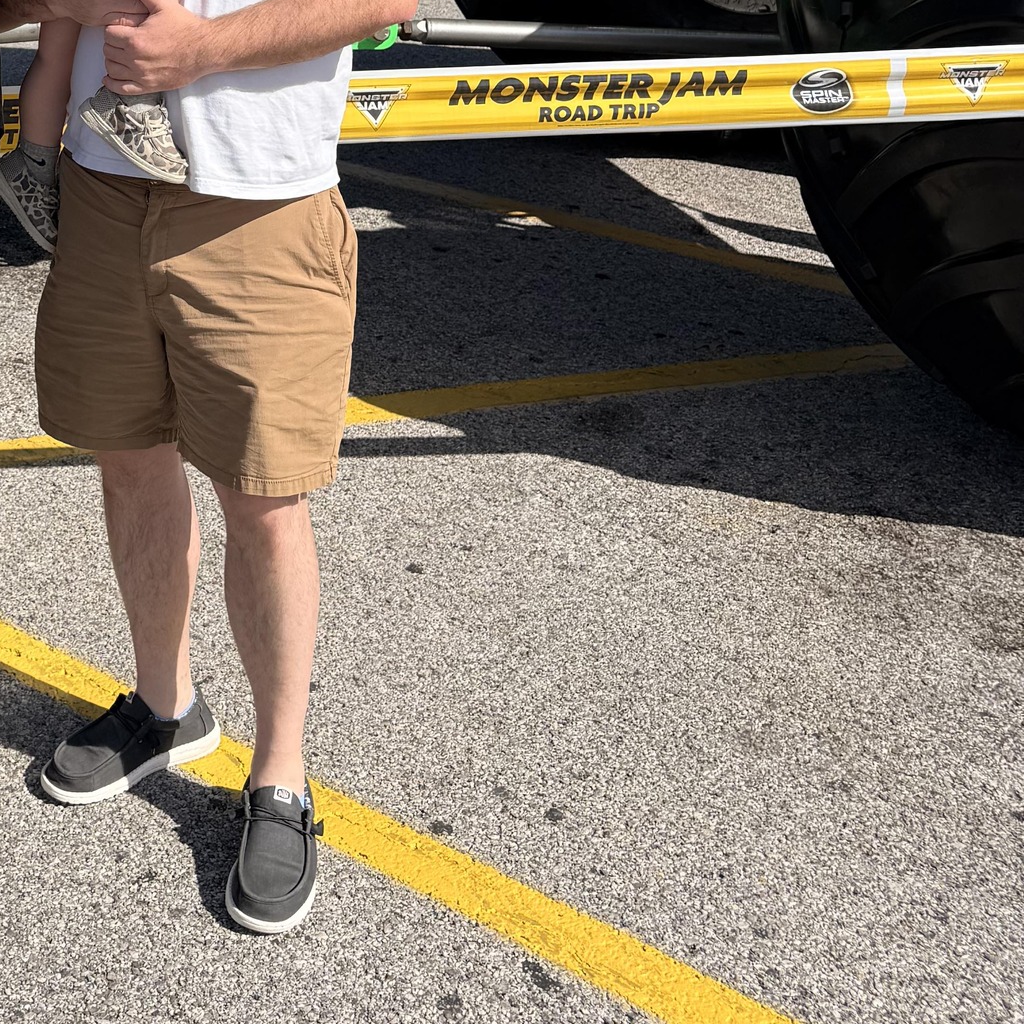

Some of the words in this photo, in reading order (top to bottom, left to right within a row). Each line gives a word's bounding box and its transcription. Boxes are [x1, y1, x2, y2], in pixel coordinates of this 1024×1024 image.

[940, 69, 1005, 79] MONSTER
[448, 73, 654, 106] MONSTER
[658, 70, 747, 105] JAM
[799, 90, 842, 98] SPIN
[357, 101, 389, 110] JAM
[538, 104, 603, 122] ROAD
[609, 103, 660, 120] TRIP
